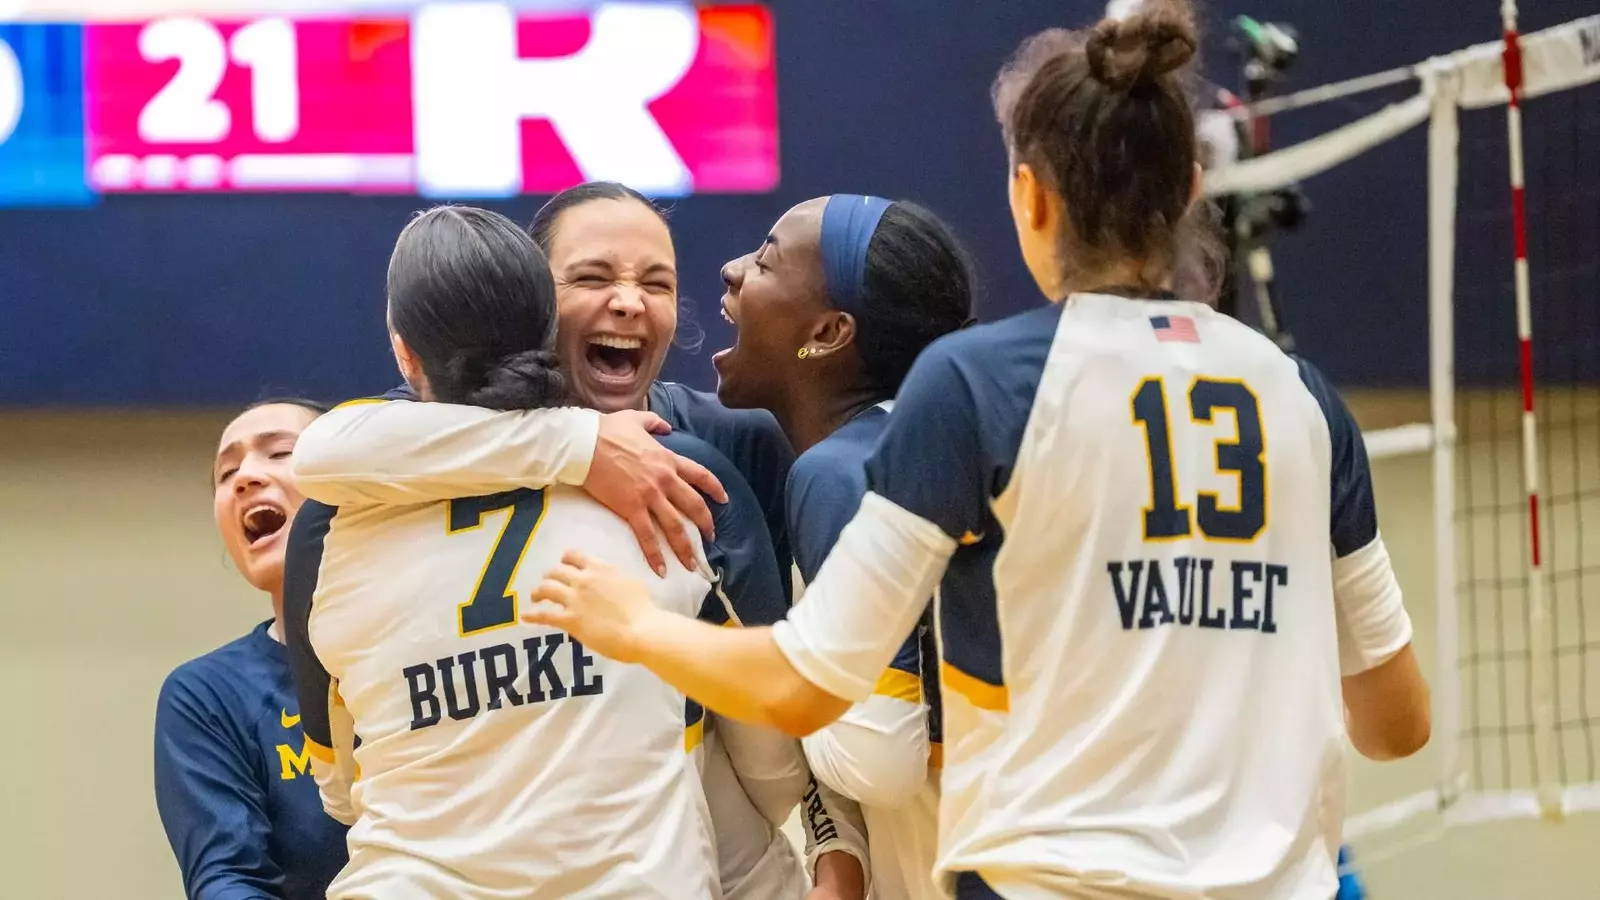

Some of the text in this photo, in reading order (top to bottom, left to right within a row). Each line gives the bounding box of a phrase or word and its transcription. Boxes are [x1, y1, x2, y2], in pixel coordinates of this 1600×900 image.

[137, 17, 298, 143] 21
[412, 2, 699, 197] R
[1129, 376, 1269, 544] 13
[446, 486, 551, 638] 7
[1107, 557, 1289, 634] VAULET
[403, 633, 604, 731] BURKE
[276, 743, 315, 780] M
